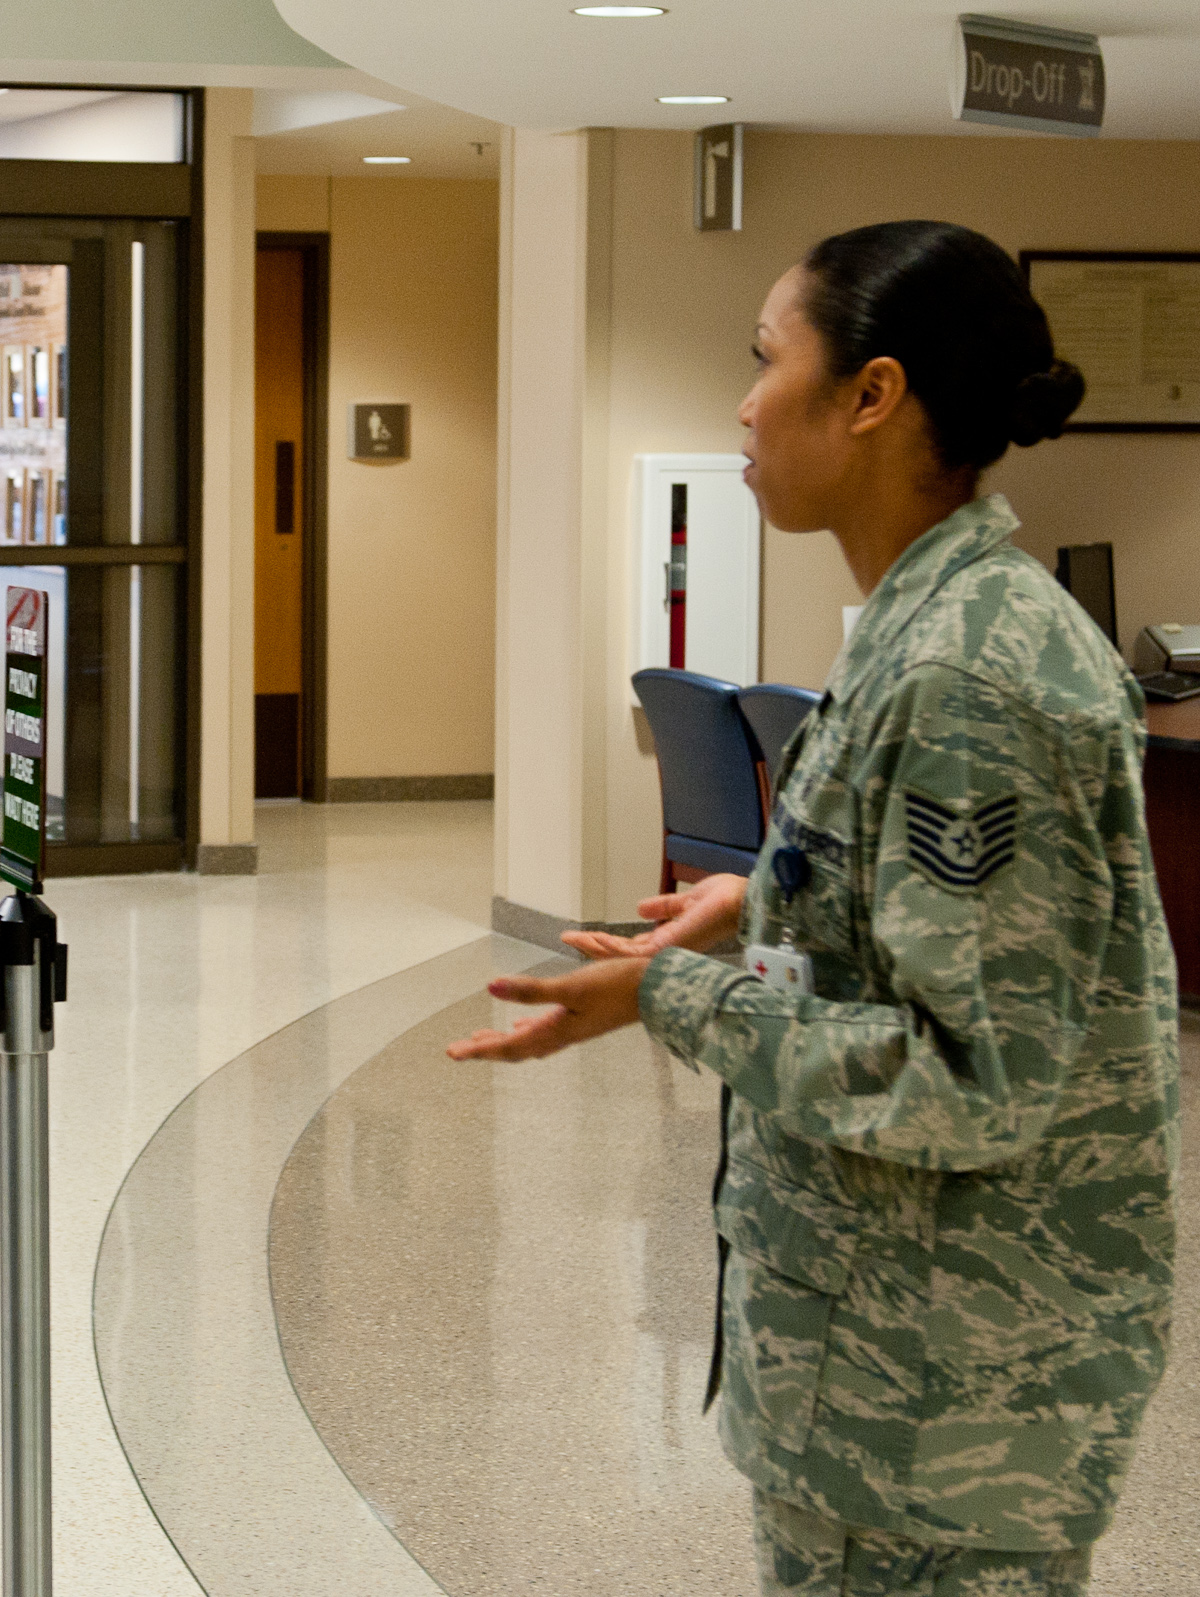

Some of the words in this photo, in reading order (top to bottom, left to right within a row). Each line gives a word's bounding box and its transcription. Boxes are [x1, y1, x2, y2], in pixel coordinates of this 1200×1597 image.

[969, 50, 1066, 108] Drop-Off
[24, 628, 38, 656] THE
[6, 708, 15, 734] OF
[15, 711, 41, 744] OTHERS
[10, 751, 35, 785] PLEASE
[4, 791, 22, 822] WAIT
[22, 798, 40, 831] HERE
